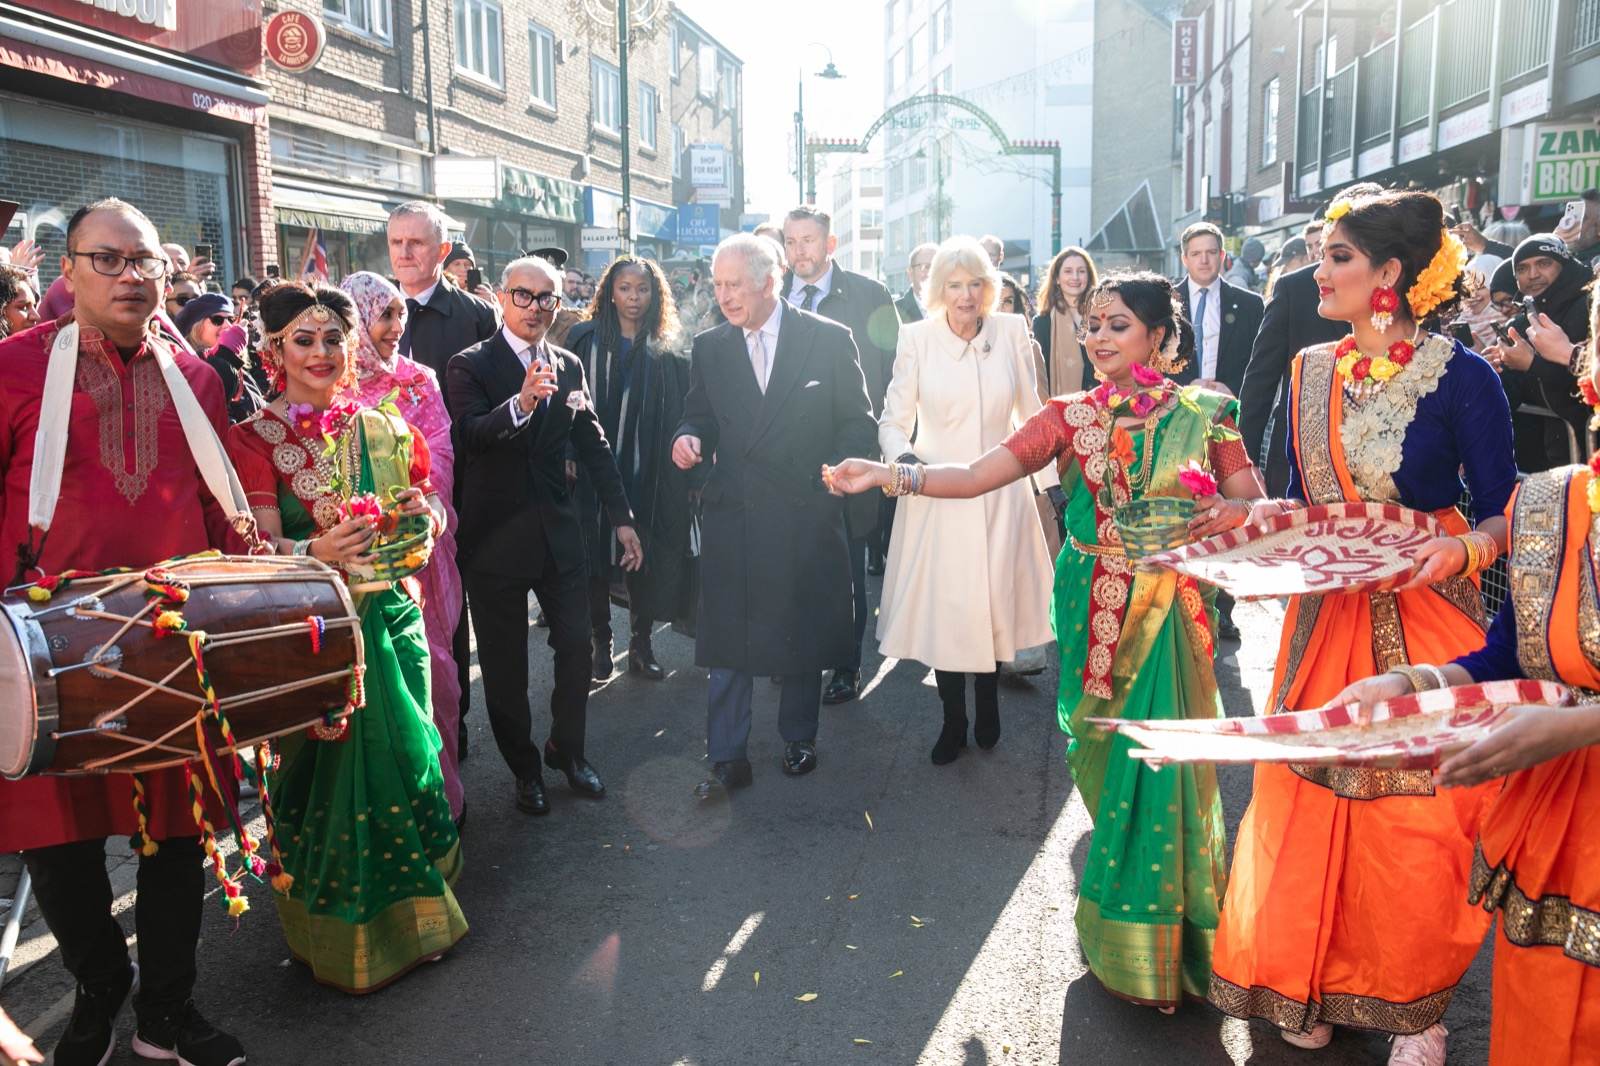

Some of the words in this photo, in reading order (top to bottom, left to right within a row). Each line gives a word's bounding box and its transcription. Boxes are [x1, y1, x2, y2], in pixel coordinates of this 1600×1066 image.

[1181, 26, 1192, 77] HOTEL
[192, 91, 213, 110] 020
[700, 156, 716, 164] SHOP
[693, 166, 705, 174] FOR
[706, 166, 722, 175] RENT
[689, 219, 706, 227] OFF
[681, 227, 715, 235] LICENCE
